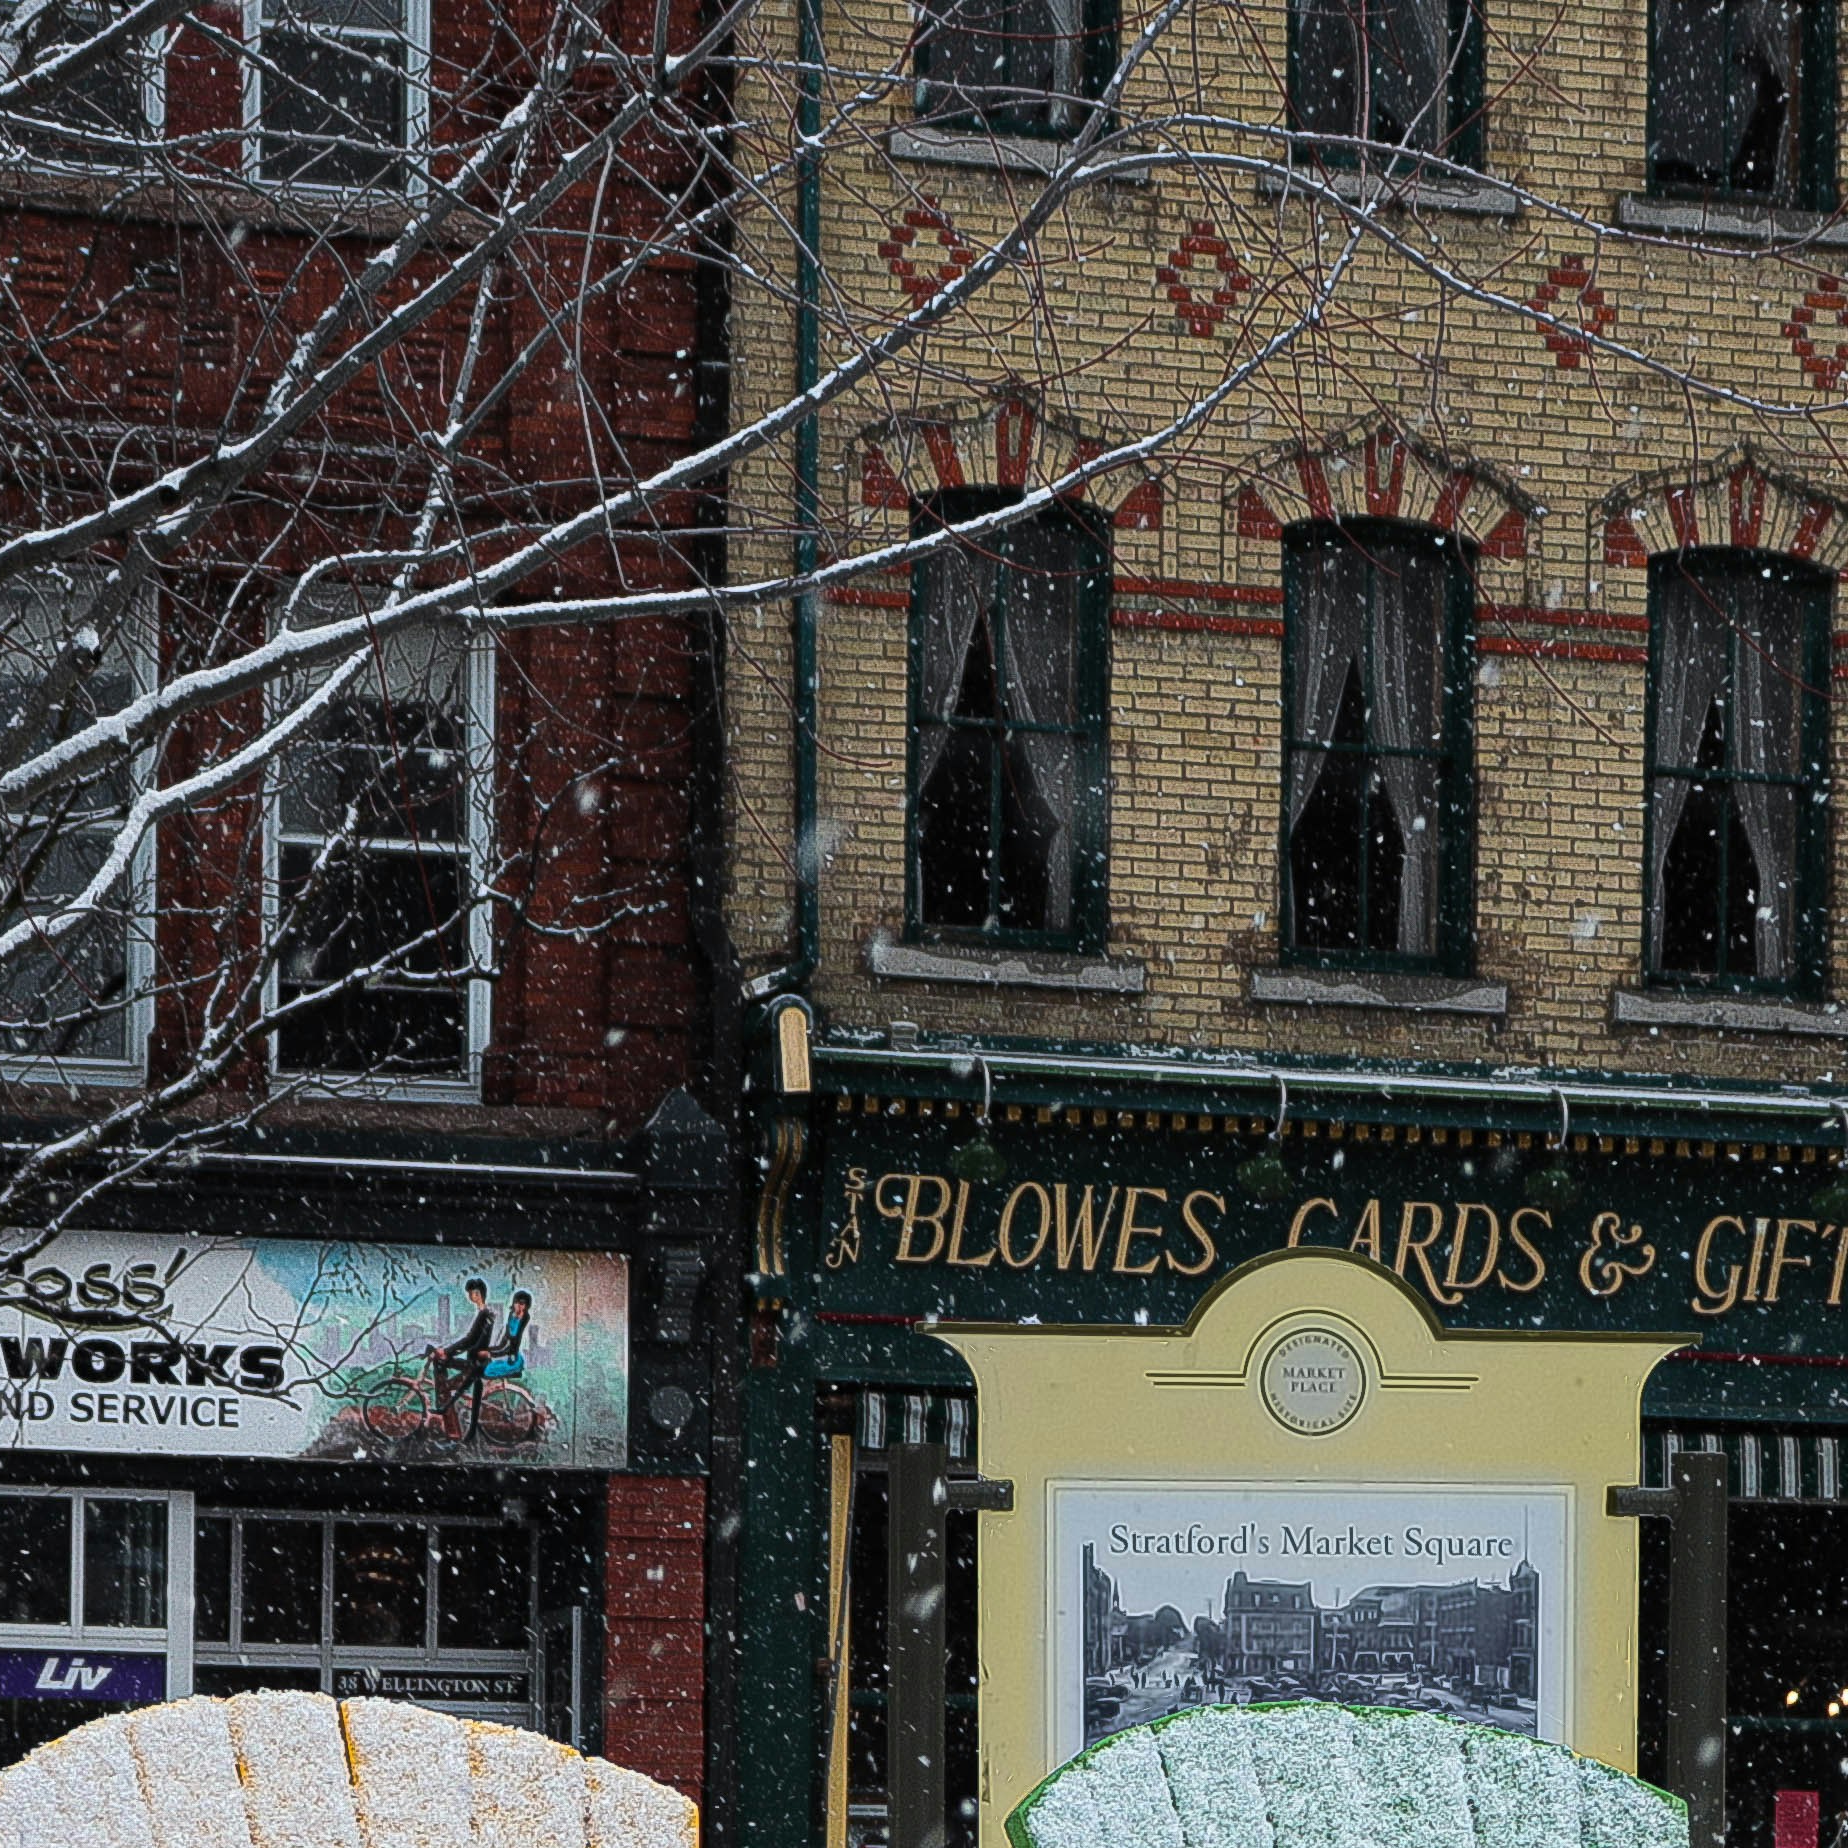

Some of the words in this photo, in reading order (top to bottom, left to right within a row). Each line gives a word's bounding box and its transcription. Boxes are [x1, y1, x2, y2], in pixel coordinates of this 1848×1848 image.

[826, 1167, 869, 1269] STAN
[875, 1173, 1227, 1276] BLOWES
[1286, 1198, 1554, 1305] CARDS
[1580, 1211, 1656, 1297] &
[1282, 1367, 1346, 1379] MARKET
[1290, 1381, 1336, 1393] PLACE
[69, 1393, 240, 1429] SERVICE
[1109, 1522, 1270, 1556] Stratford's
[1279, 1525, 1394, 1557] Market
[1403, 1525, 1514, 1566] Square
[35, 1656, 113, 1693] Liv
[363, 1675, 490, 1694] WELLINGTON
